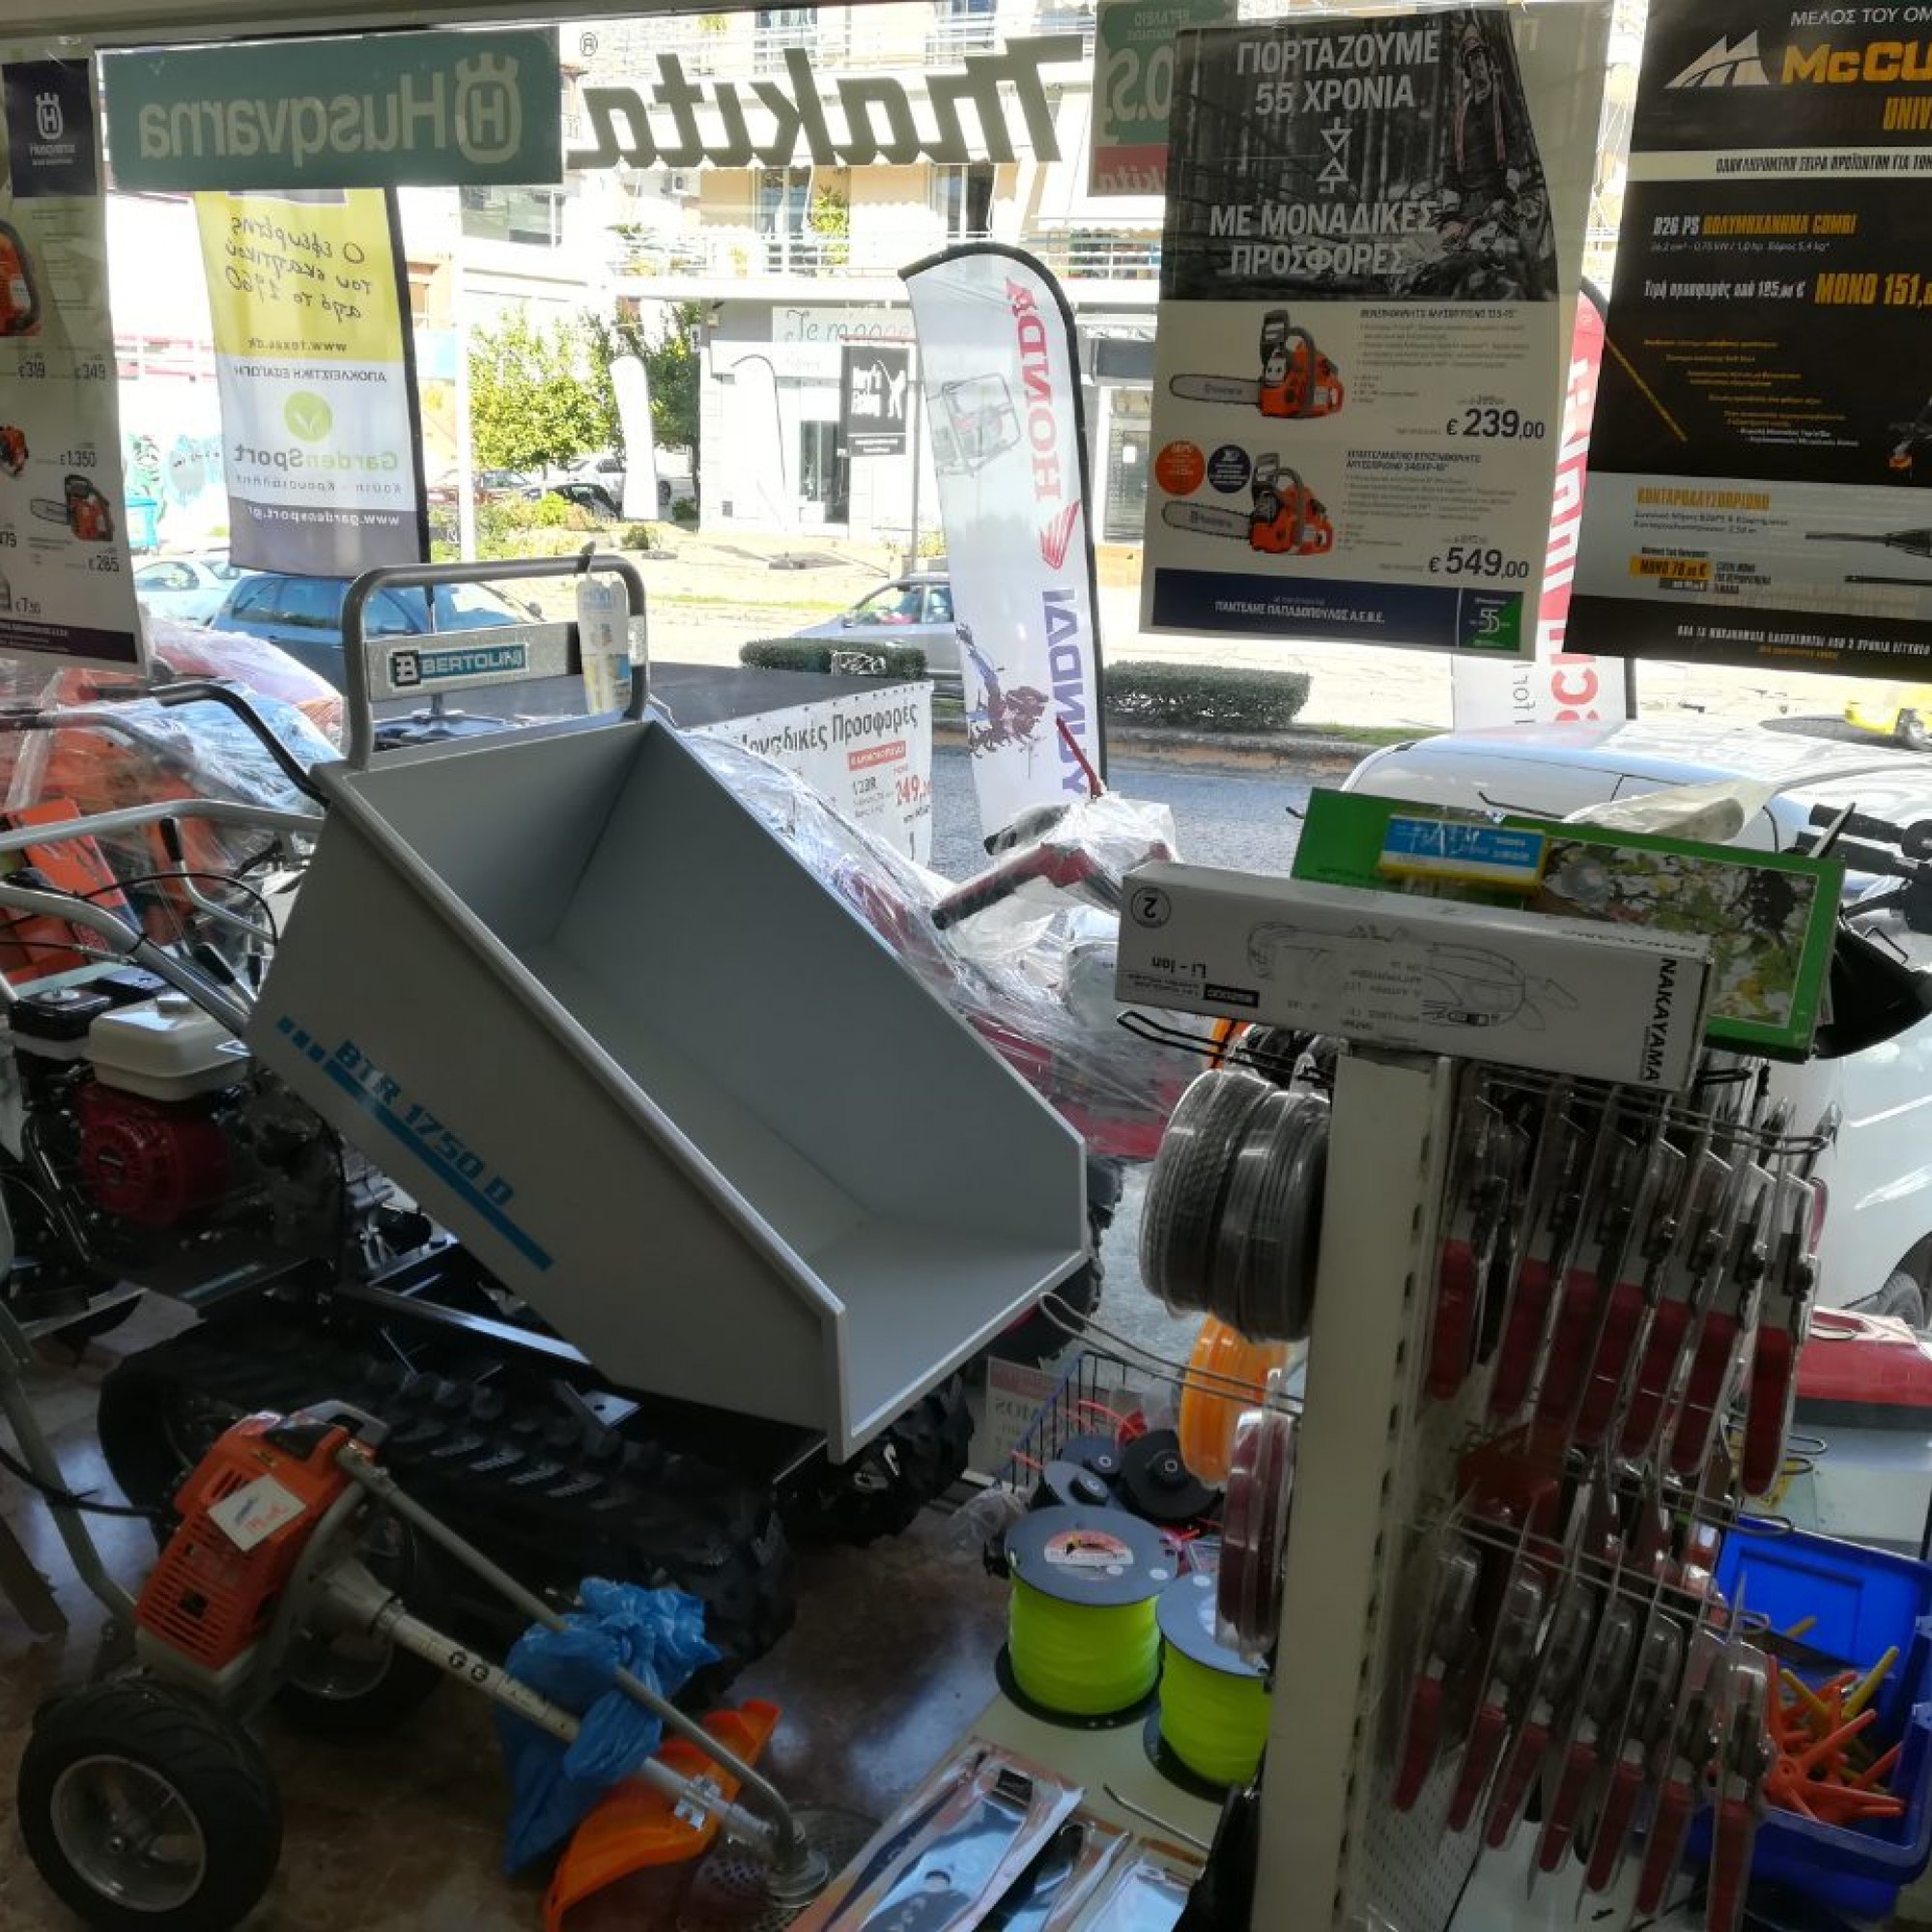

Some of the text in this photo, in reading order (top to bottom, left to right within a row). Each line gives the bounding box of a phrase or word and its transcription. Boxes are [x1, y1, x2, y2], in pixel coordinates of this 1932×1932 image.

[1791, 10, 1856, 26] ΜΕΛΟΣ
[1862, 8, 1899, 23] ΤΟΥ
[1236, 29, 1441, 74] ΓΙΟΡΤΑΖΟΥΜΕ
[1256, 74, 1414, 115] 55 ΧΡΟΝΙΑ
[1209, 201, 1438, 237] ΜΕ ΜΟΝΑΔΙΚΕΣ
[1231, 243, 1409, 274] ΠΡΟΣΦΟΡΕΣ
[1814, 273, 1879, 304] ΜΟΝΟ
[1446, 409, 1545, 440] € 239,00
[1430, 547, 1529, 580] € 549,00
[421, 649, 524, 675] BERTOLINI
[1144, 895, 1158, 919] 2
[1645, 957, 1678, 1083] NAKAYAMA
[335, 1039, 515, 1206] BTR 1750 D
